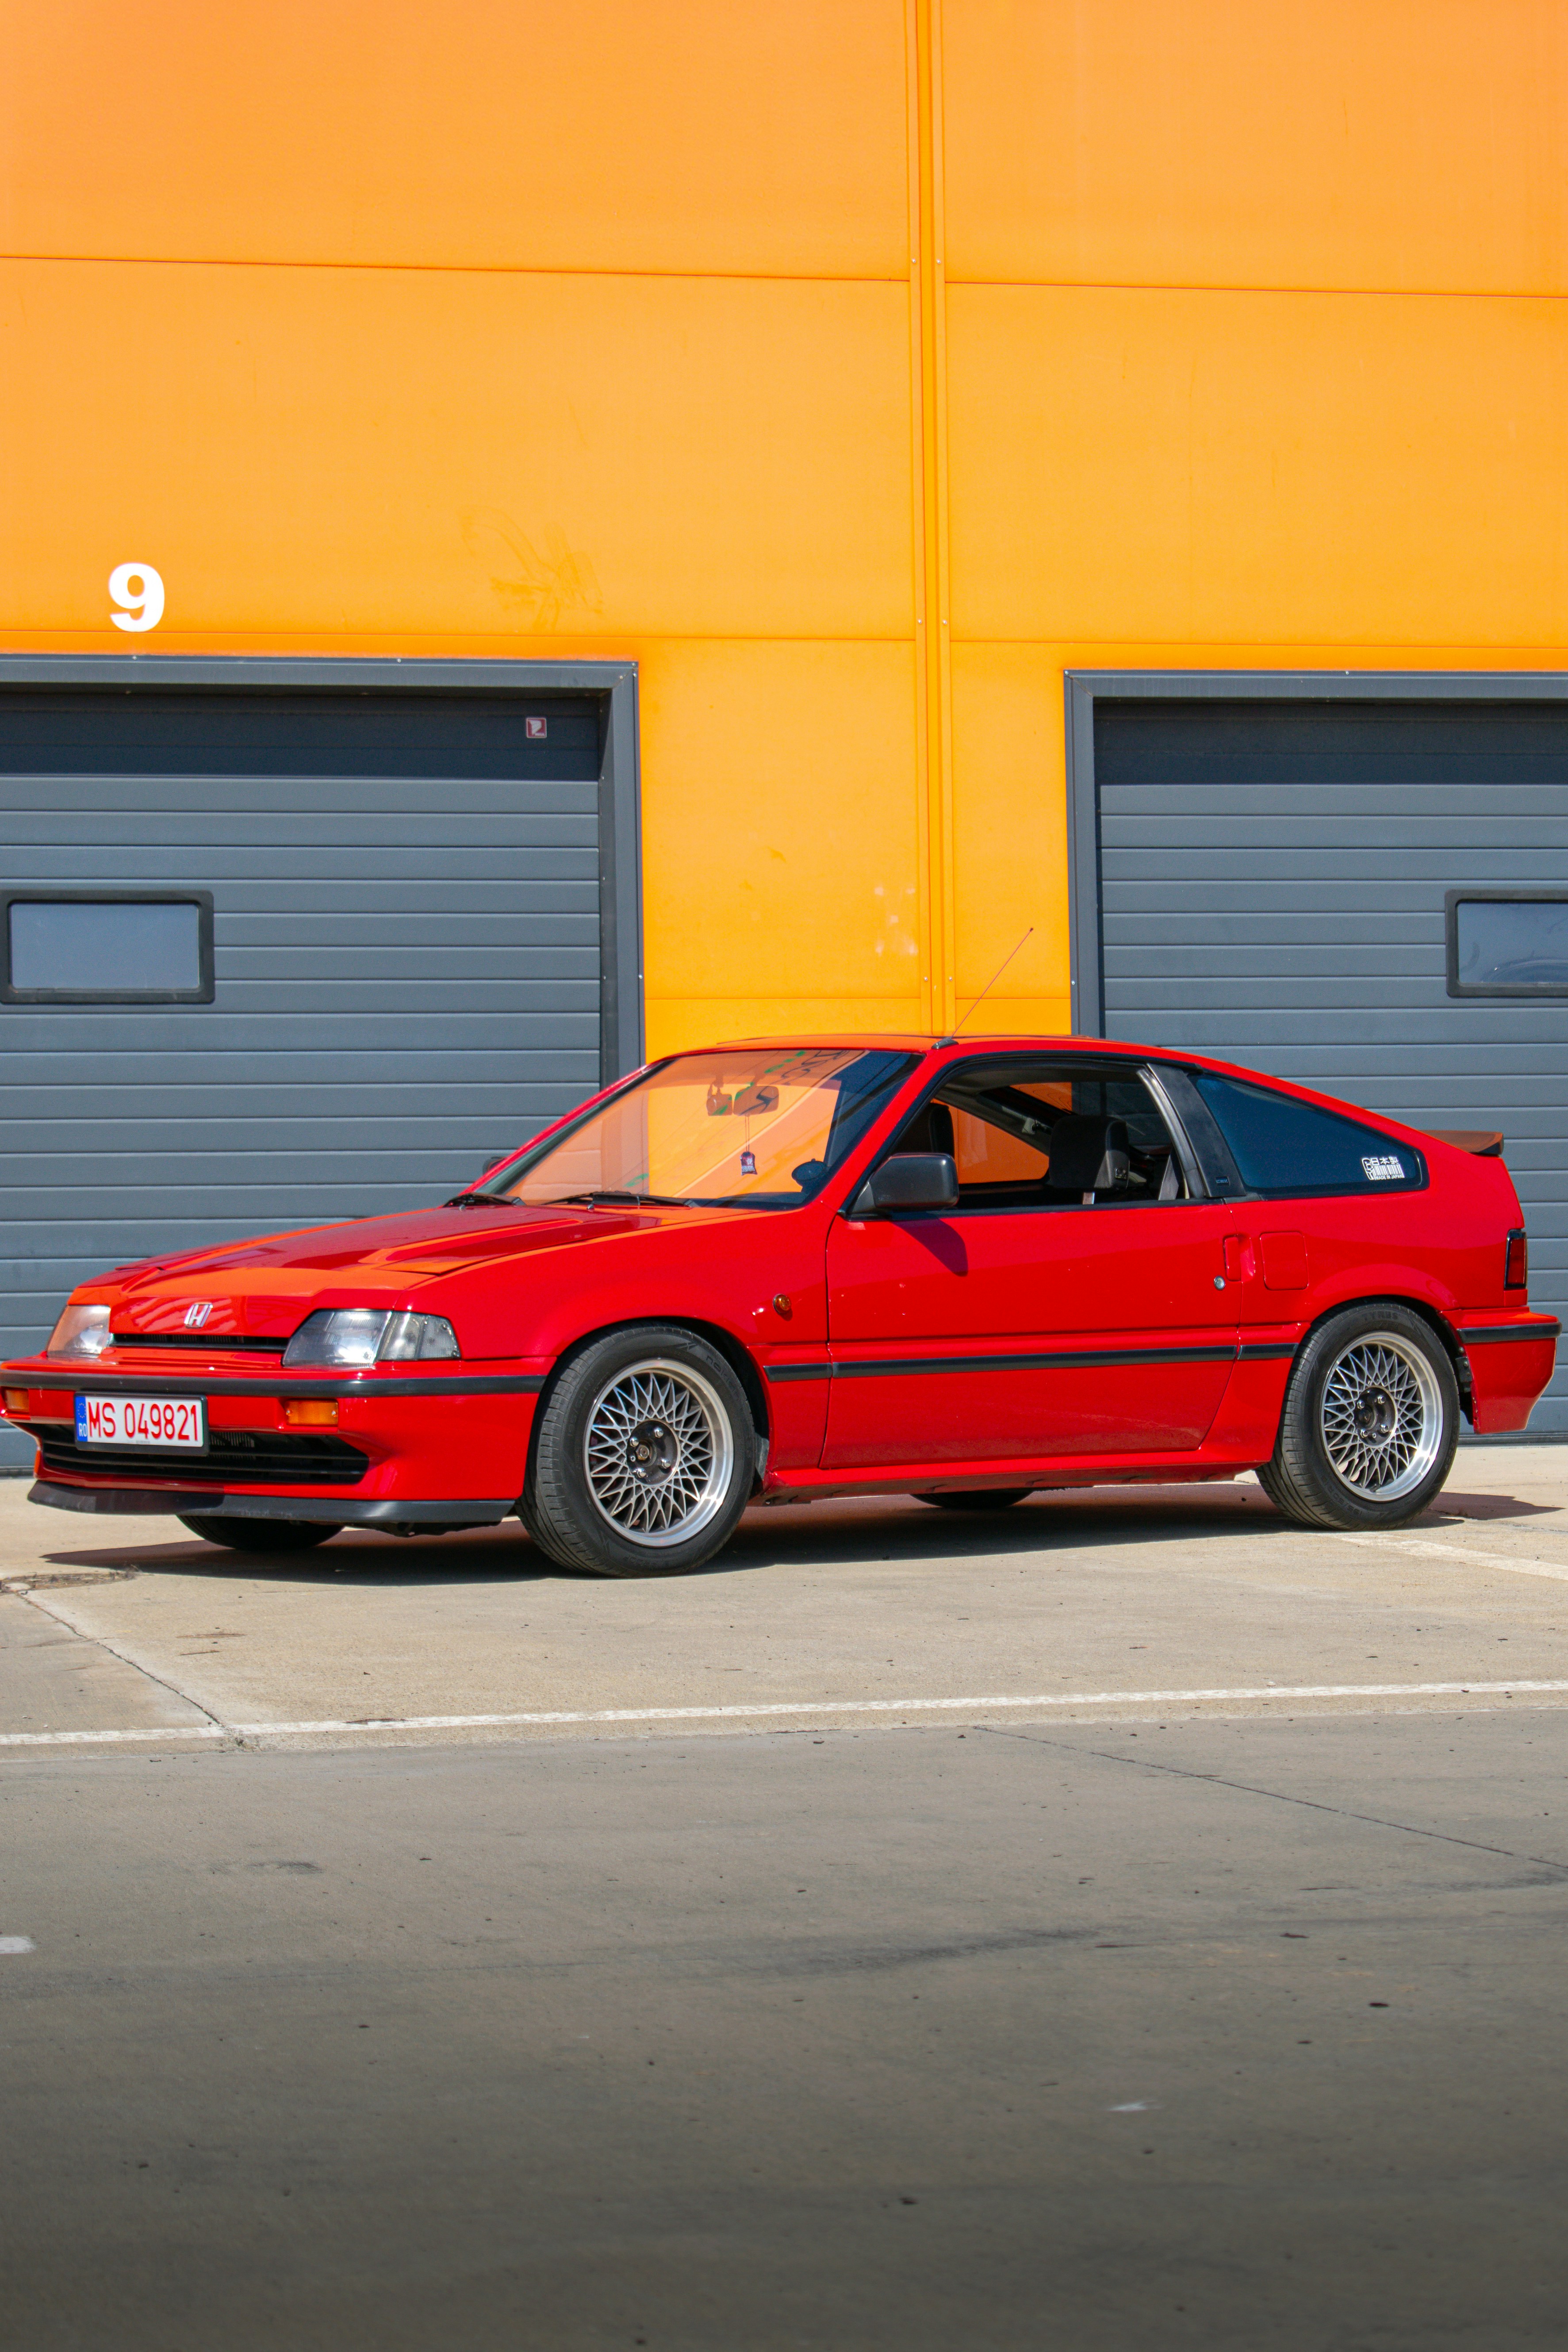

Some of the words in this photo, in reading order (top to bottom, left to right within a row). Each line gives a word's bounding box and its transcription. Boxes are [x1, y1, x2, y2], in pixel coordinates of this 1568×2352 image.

[108, 562, 165, 632] 9
[1370, 1156, 1399, 1166] 日本製
[79, 1423, 88, 1437] RO
[88, 1402, 116, 1437] MS
[124, 1403, 198, 1441] 049821
